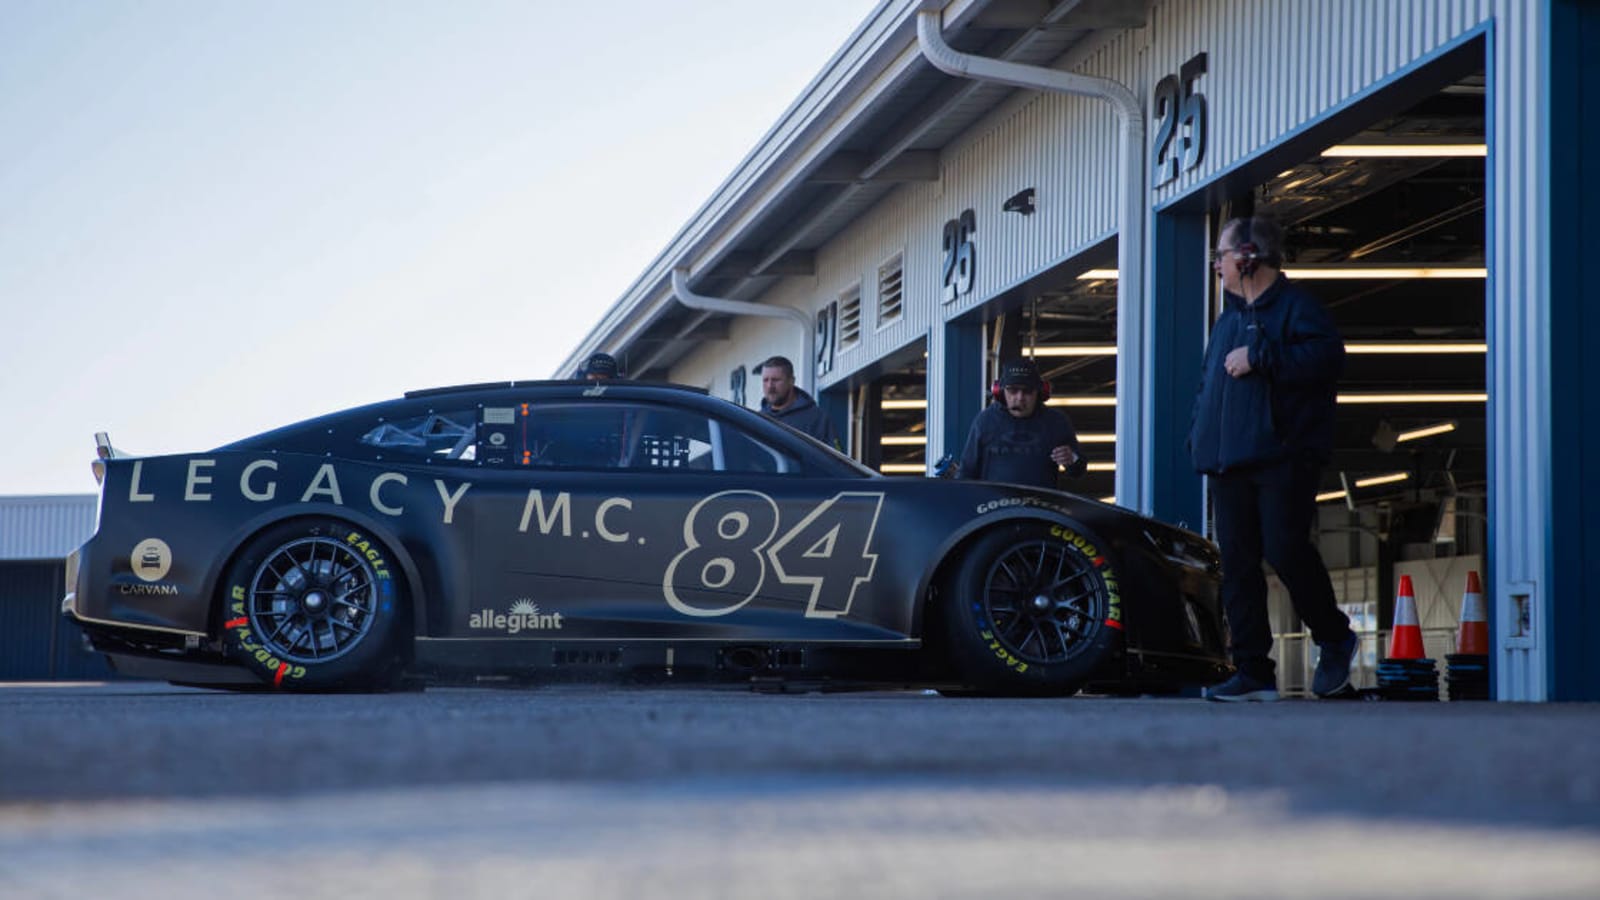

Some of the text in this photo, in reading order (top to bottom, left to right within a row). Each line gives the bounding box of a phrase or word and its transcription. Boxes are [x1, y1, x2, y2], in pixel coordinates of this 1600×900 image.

[1152, 52, 1208, 189] 25
[942, 208, 976, 305] 26
[128, 458, 646, 545] LEGACY M.C.
[120, 584, 178, 595] CARVANA
[347, 532, 390, 579] EAGLE
[663, 489, 885, 619] 84
[231, 585, 306, 679] GOODYAR
[469, 609, 562, 634] allegiant
[981, 630, 1028, 672] EAGLE
